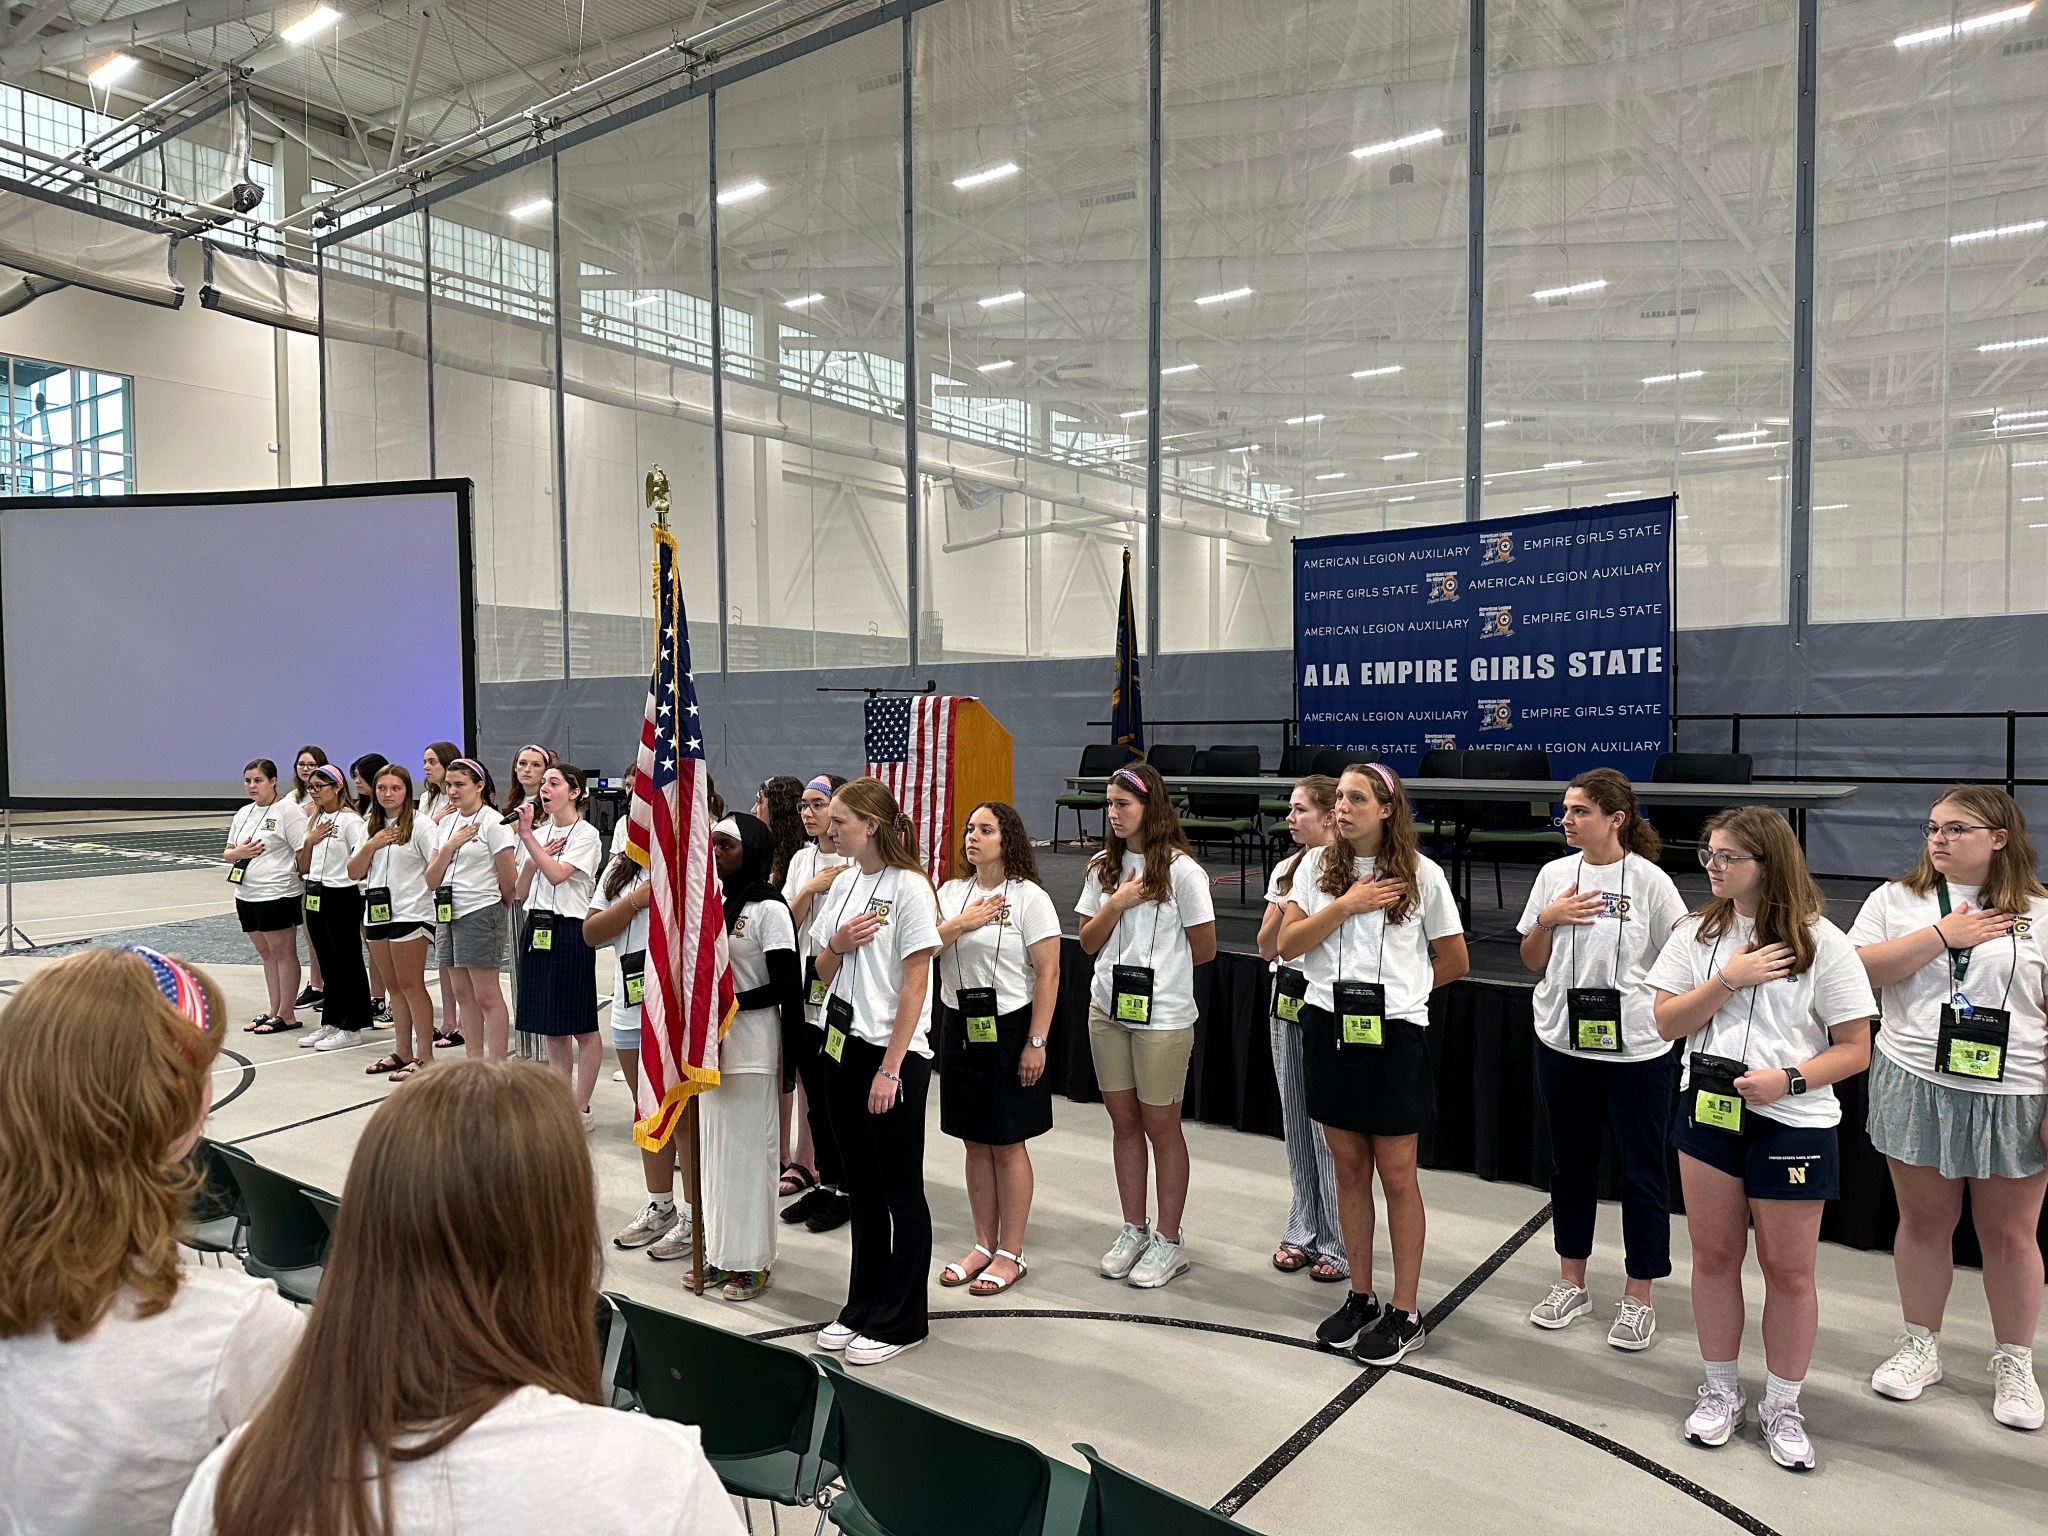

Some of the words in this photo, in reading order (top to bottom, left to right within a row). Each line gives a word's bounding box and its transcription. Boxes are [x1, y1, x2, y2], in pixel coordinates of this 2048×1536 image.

[1523, 535, 1572, 551] EMPIRE
[1576, 530, 1614, 545] GIRLS
[1618, 524, 1662, 540] STATE
[1303, 556, 1359, 569] AMERICAN
[1363, 552, 1405, 565] LEGION
[1408, 546, 1471, 561] AUXILIARY
[1468, 575, 1535, 590] AMERICAN
[1539, 570, 1587, 584] LEGION
[1591, 561, 1662, 579] AUXILIARY
[1304, 589, 1344, 601] EMPIRE
[1346, 587, 1379, 599] GIRLS
[1382, 584, 1419, 597] STATE
[1522, 611, 1572, 625] EMPIRE
[1575, 607, 1615, 621] GIRLS
[1618, 603, 1662, 617] STATE
[1304, 625, 1359, 637] AMERICAN
[1362, 622, 1404, 634] LEGION
[1407, 618, 1470, 631] AUXILIARY
[1303, 663, 1350, 687] ALA
[1361, 658, 1458, 685] EMPIRE
[1470, 653, 1555, 682] GIRLS
[1568, 646, 1663, 678] STATE
[1304, 712, 1359, 722] AMERICAN
[1362, 711, 1404, 722] LEGION
[1407, 710, 1468, 721] AUXILIARY
[1521, 707, 1571, 719] EMPIRE
[1574, 705, 1614, 717] GIRLS
[1618, 703, 1661, 716] STATE
[1381, 744, 1417, 754] STATE
[1590, 741, 1661, 753] AUXILIARY
[1787, 1167, 1806, 1184] N
